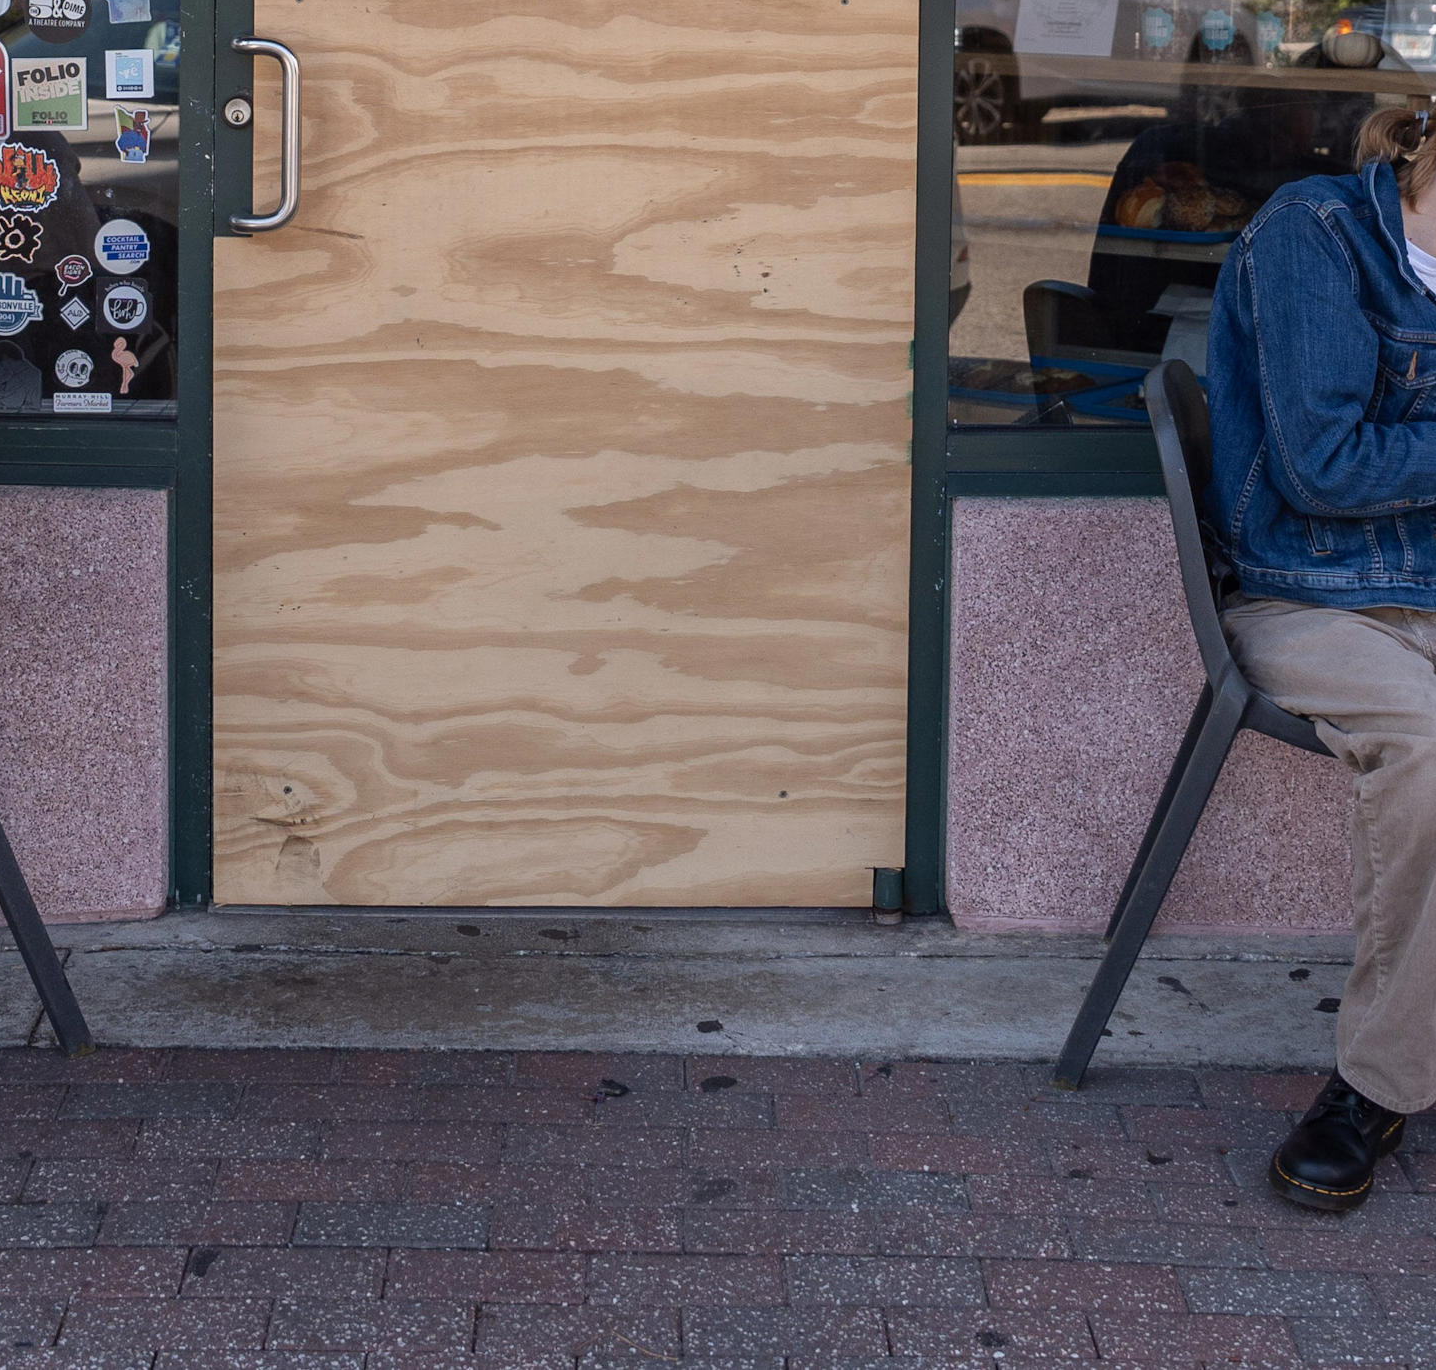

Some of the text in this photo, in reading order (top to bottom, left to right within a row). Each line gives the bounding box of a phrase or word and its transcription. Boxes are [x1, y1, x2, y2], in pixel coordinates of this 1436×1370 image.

[64, 1, 85, 15] DIME
[33, 18, 58, 27] THEATRE
[58, 19, 86, 28] COMPANY
[16, 63, 81, 87] FOLIO
[16, 79, 81, 103] INSIDE
[32, 110, 68, 120] FOLIO
[55, 399, 109, 407] Farmers Market
